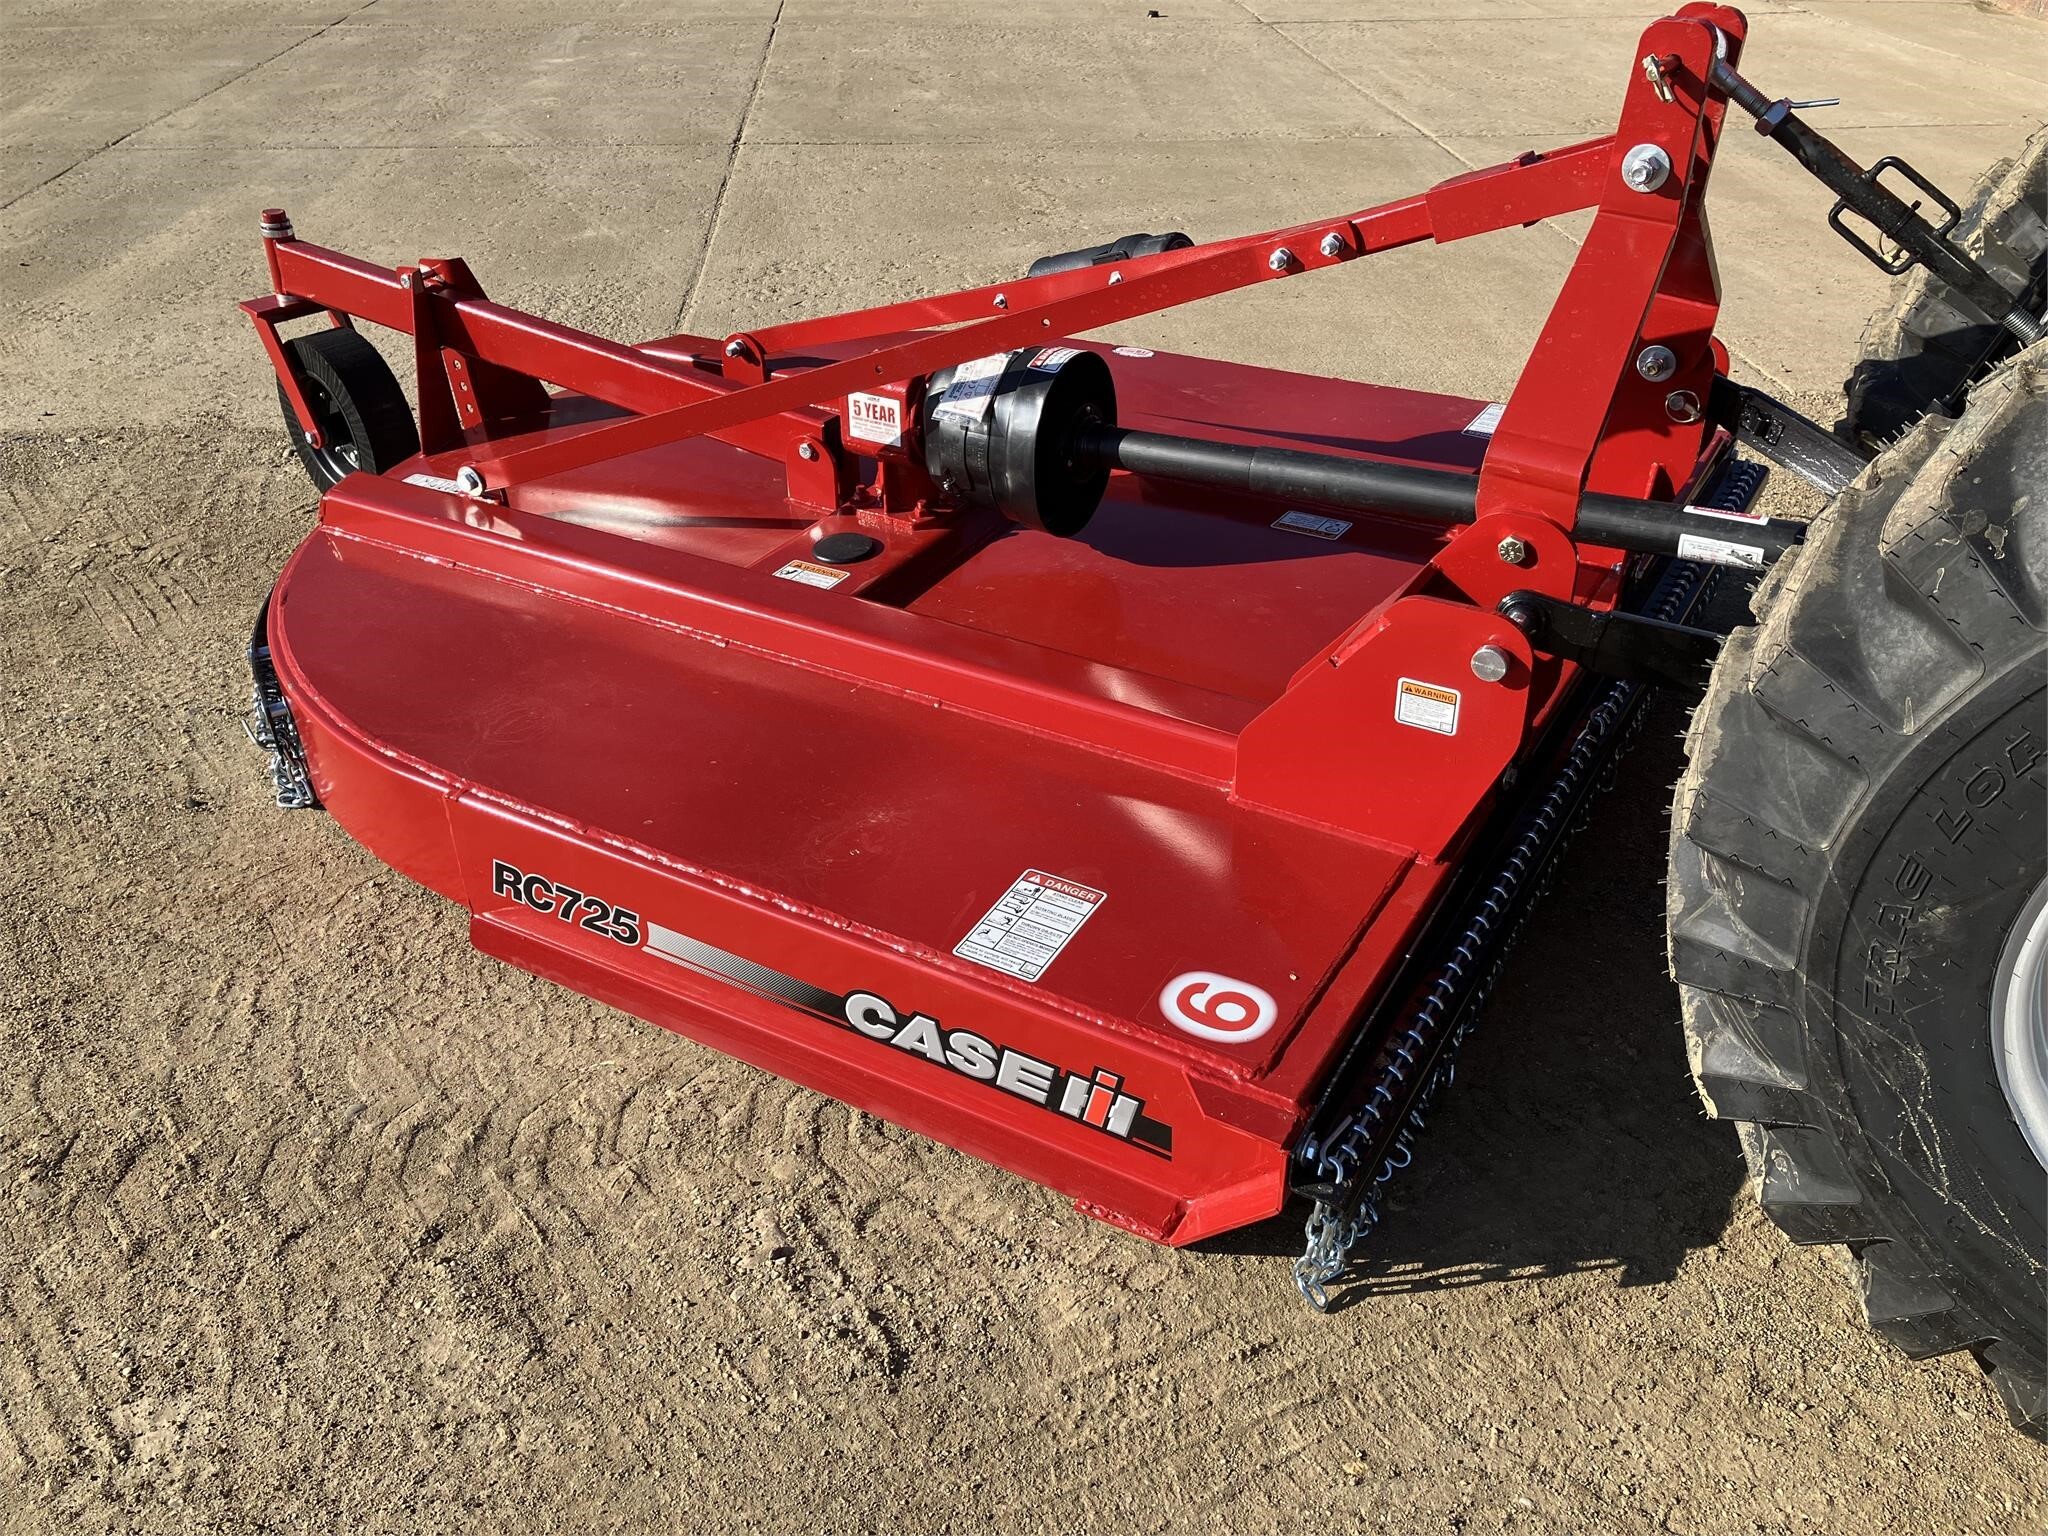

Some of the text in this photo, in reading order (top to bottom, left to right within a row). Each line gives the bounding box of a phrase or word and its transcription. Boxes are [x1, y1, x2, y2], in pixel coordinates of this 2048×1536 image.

[853, 399, 861, 416] 5
[864, 402, 896, 424] YEAR
[1414, 686, 1454, 703] WARNING
[492, 858, 641, 947] RC725
[1044, 878, 1096, 903] DANGER
[845, 993, 1055, 1104] CASE
